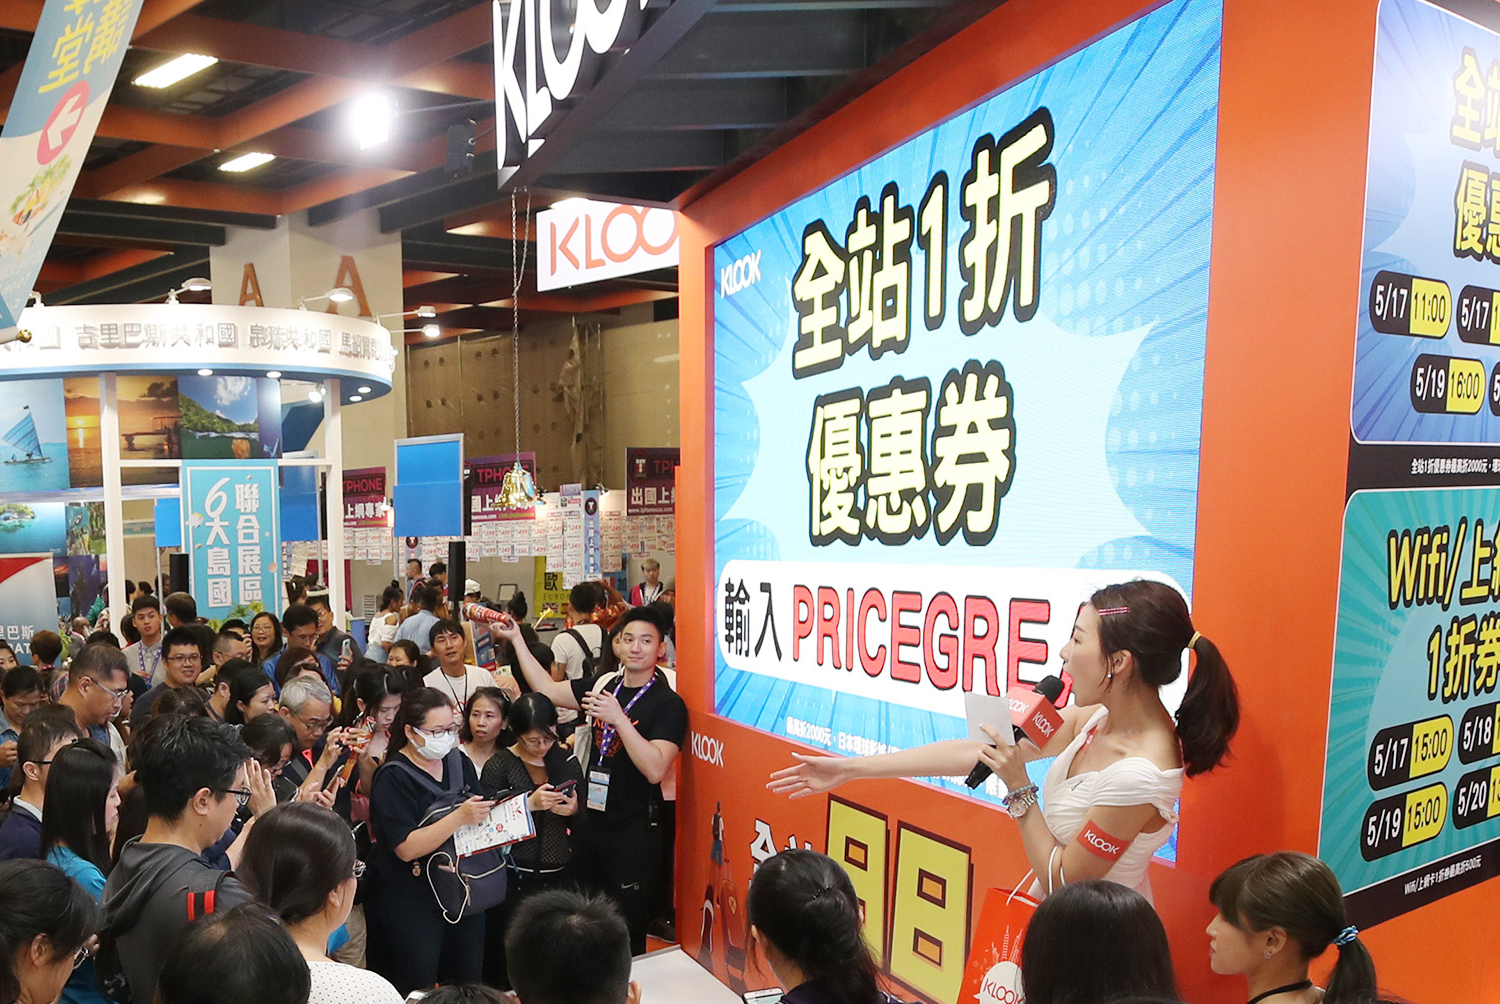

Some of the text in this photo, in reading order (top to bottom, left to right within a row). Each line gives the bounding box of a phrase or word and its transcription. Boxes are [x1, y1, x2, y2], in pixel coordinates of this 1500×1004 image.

[793, 118, 1053, 372] 全站1折
[239, 262, 264, 307] A
[327, 255, 372, 317] A
[719, 249, 762, 299] KLOOK
[1375, 284, 1446, 324] 5/17 11:00
[1461, 298, 1490, 330] 5/17
[1415, 366, 1446, 399] 5/19
[1451, 370, 1481, 400] 16:00
[807, 366, 1013, 544] 優惠券
[204, 477, 232, 608] 6大島國
[235, 483, 263, 605] 聯合展區
[724, 578, 782, 660] 輸入
[1032, 711, 1054, 738] KLOOK
[1463, 719, 1492, 751] 5/18
[690, 730, 725, 768] KLOOK
[1373, 731, 1448, 776] 5/17 15:00
[1458, 780, 1487, 817] 5/20
[1084, 829, 1120, 855] KLOOK
[1366, 798, 1440, 848] 5/19 15:00
